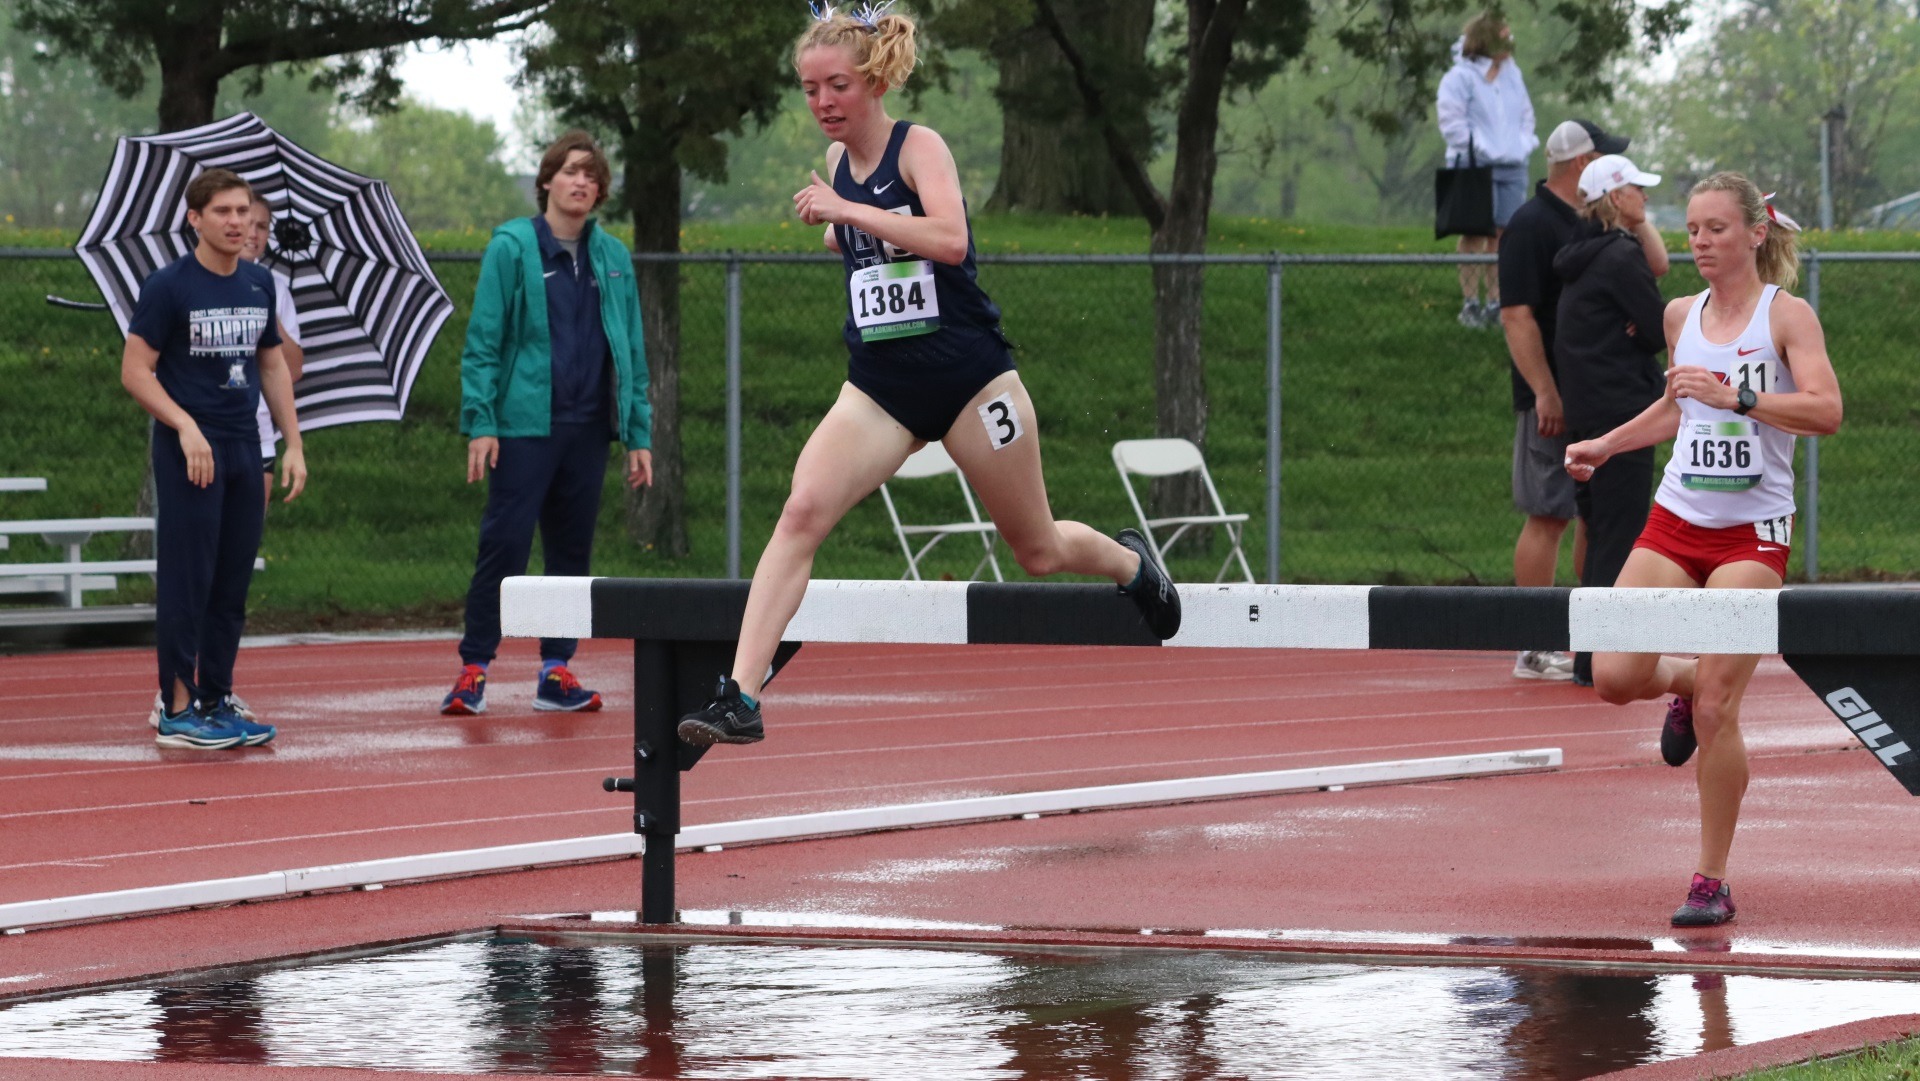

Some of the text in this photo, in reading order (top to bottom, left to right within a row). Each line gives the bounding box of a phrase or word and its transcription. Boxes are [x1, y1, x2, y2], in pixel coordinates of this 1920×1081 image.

[859, 281, 926, 318] 1384
[1738, 362, 1766, 392] 11
[987, 400, 1016, 446] 3
[1690, 439, 1751, 469] 1636
[1763, 515, 1788, 543] 11
[1825, 686, 1912, 767] GILL
